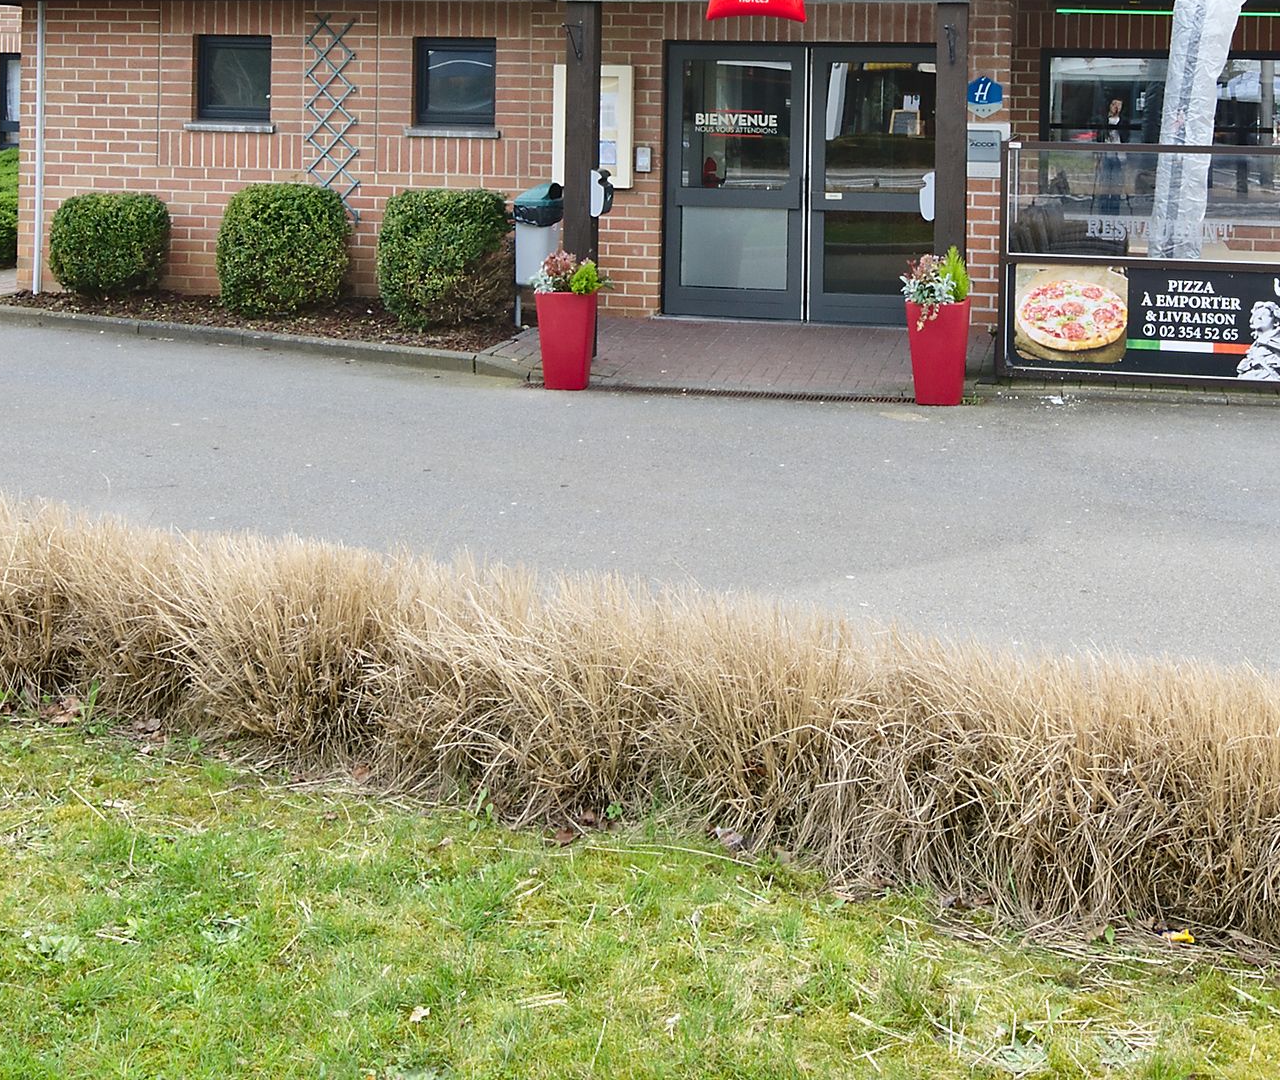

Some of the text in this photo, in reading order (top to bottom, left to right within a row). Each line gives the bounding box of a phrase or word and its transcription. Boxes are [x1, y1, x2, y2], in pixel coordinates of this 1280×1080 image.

[695, 113, 778, 127] BIENVENUE
[715, 126, 734, 134] VOUS
[735, 127, 778, 135] ATTENDIONS
[1167, 279, 1214, 294] PIZZA
[1141, 292, 1242, 311] À EMPORTER
[1146, 310, 1236, 325] & LIVRAISON
[1159, 324, 1239, 341] 02 354 52 65
